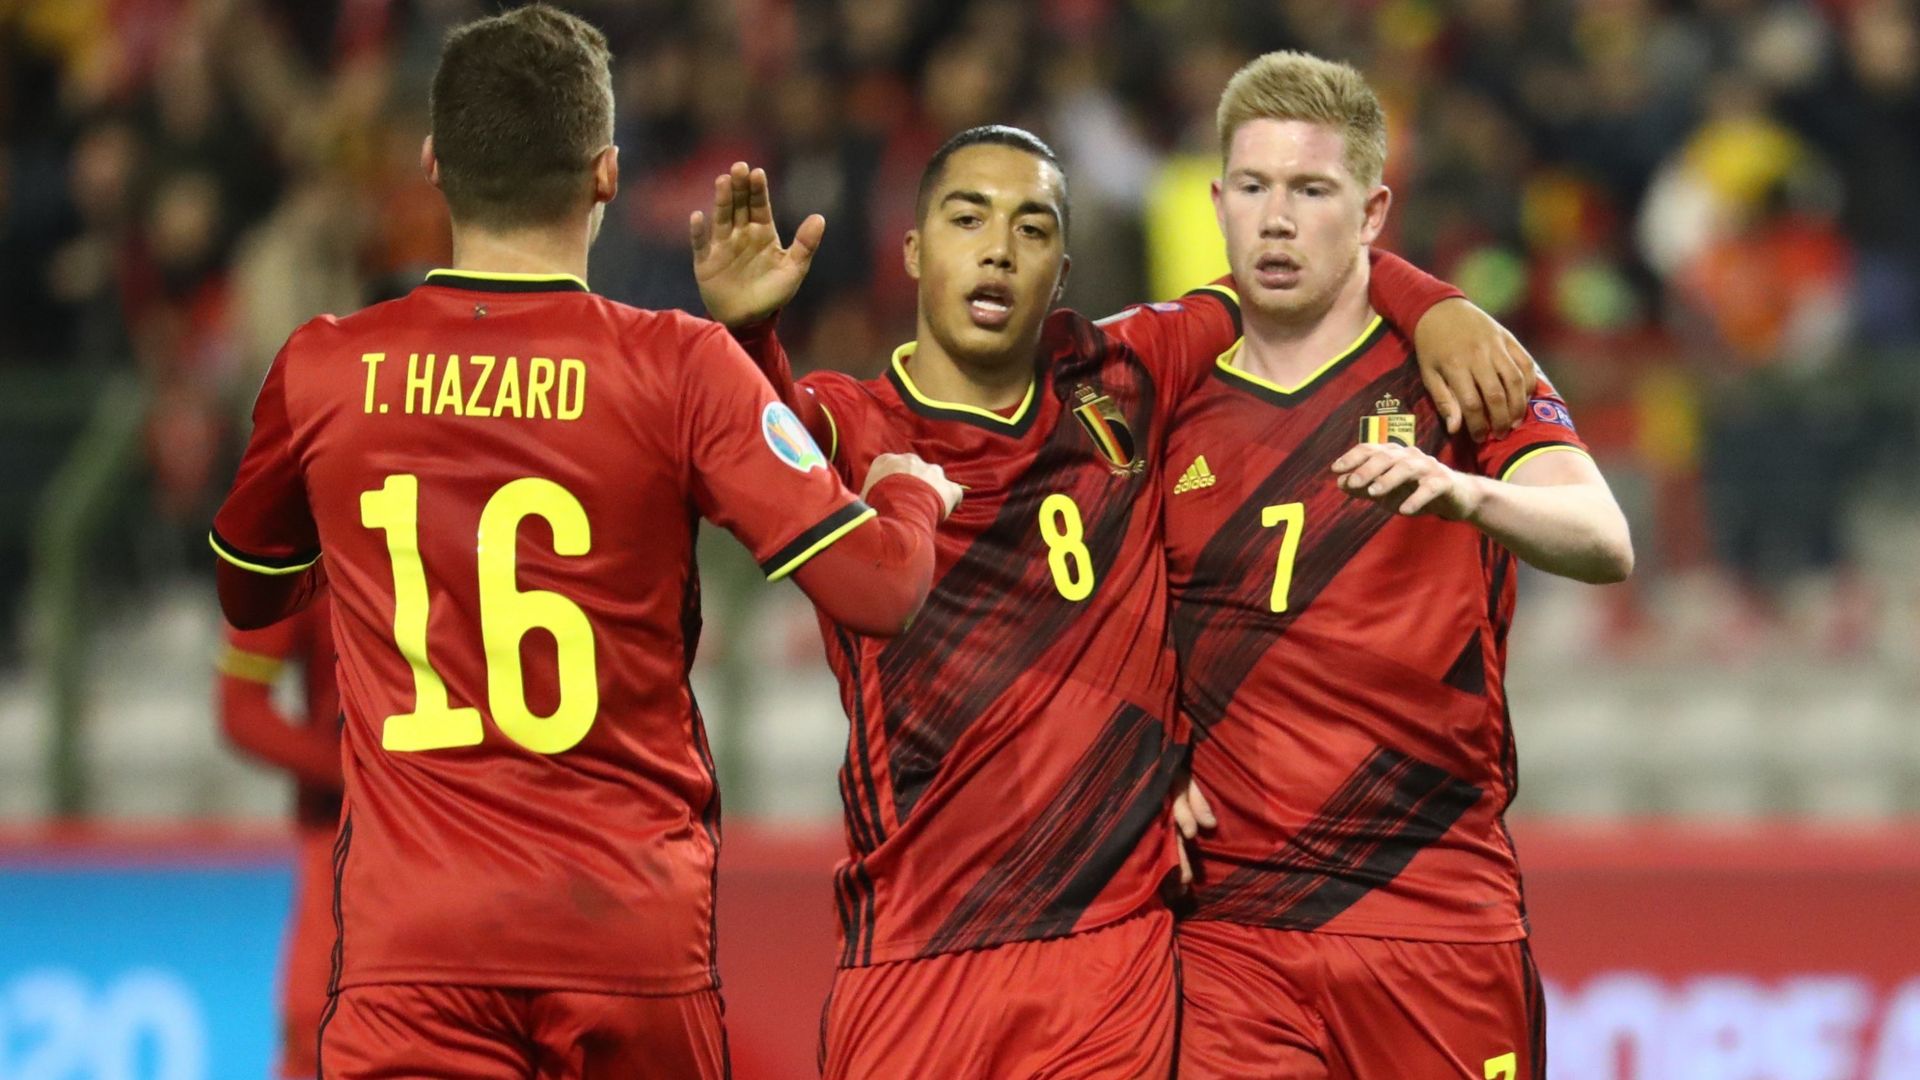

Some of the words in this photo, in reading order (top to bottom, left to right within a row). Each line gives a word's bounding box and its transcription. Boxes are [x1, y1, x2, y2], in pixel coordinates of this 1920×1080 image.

[361, 352, 389, 414] T.
[404, 353, 587, 421] HAZARD
[1173, 474, 1217, 495] adidas
[1038, 493, 1095, 602] 8
[1261, 501, 1306, 613] 7
[359, 473, 599, 755] 16
